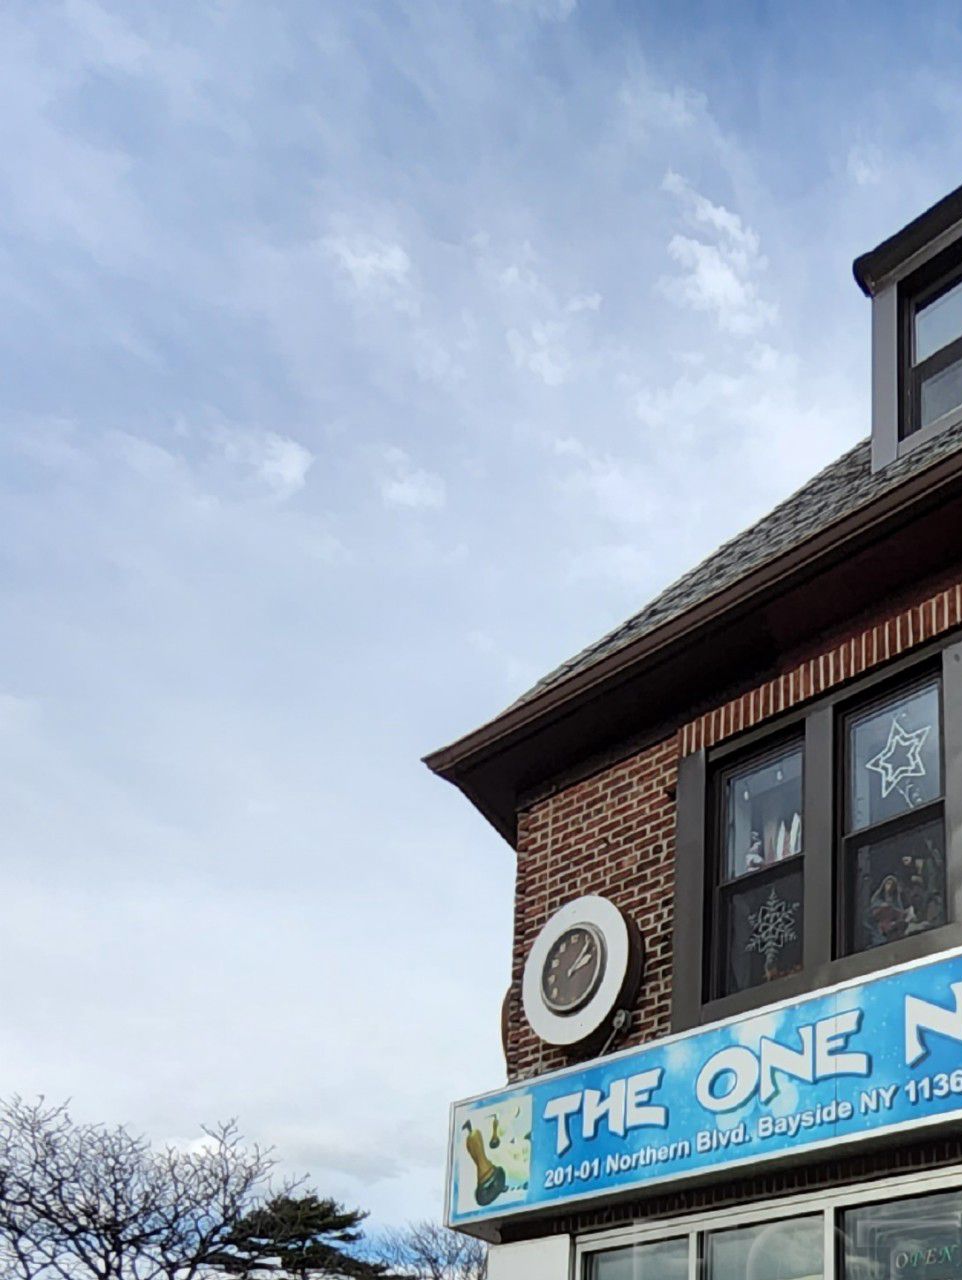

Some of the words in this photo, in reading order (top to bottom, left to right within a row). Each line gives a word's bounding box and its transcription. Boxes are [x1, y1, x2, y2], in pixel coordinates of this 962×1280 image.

[543, 1068, 668, 1156] THE
[696, 1008, 869, 1113] ONE
[543, 1157, 602, 1188] 201-01
[606, 1139, 690, 1174] Northern
[696, 1117, 751, 1155] Blvd.
[758, 1098, 852, 1140] Bayside
[858, 1082, 897, 1115] NY
[896, 1244, 958, 1269] OPEN
